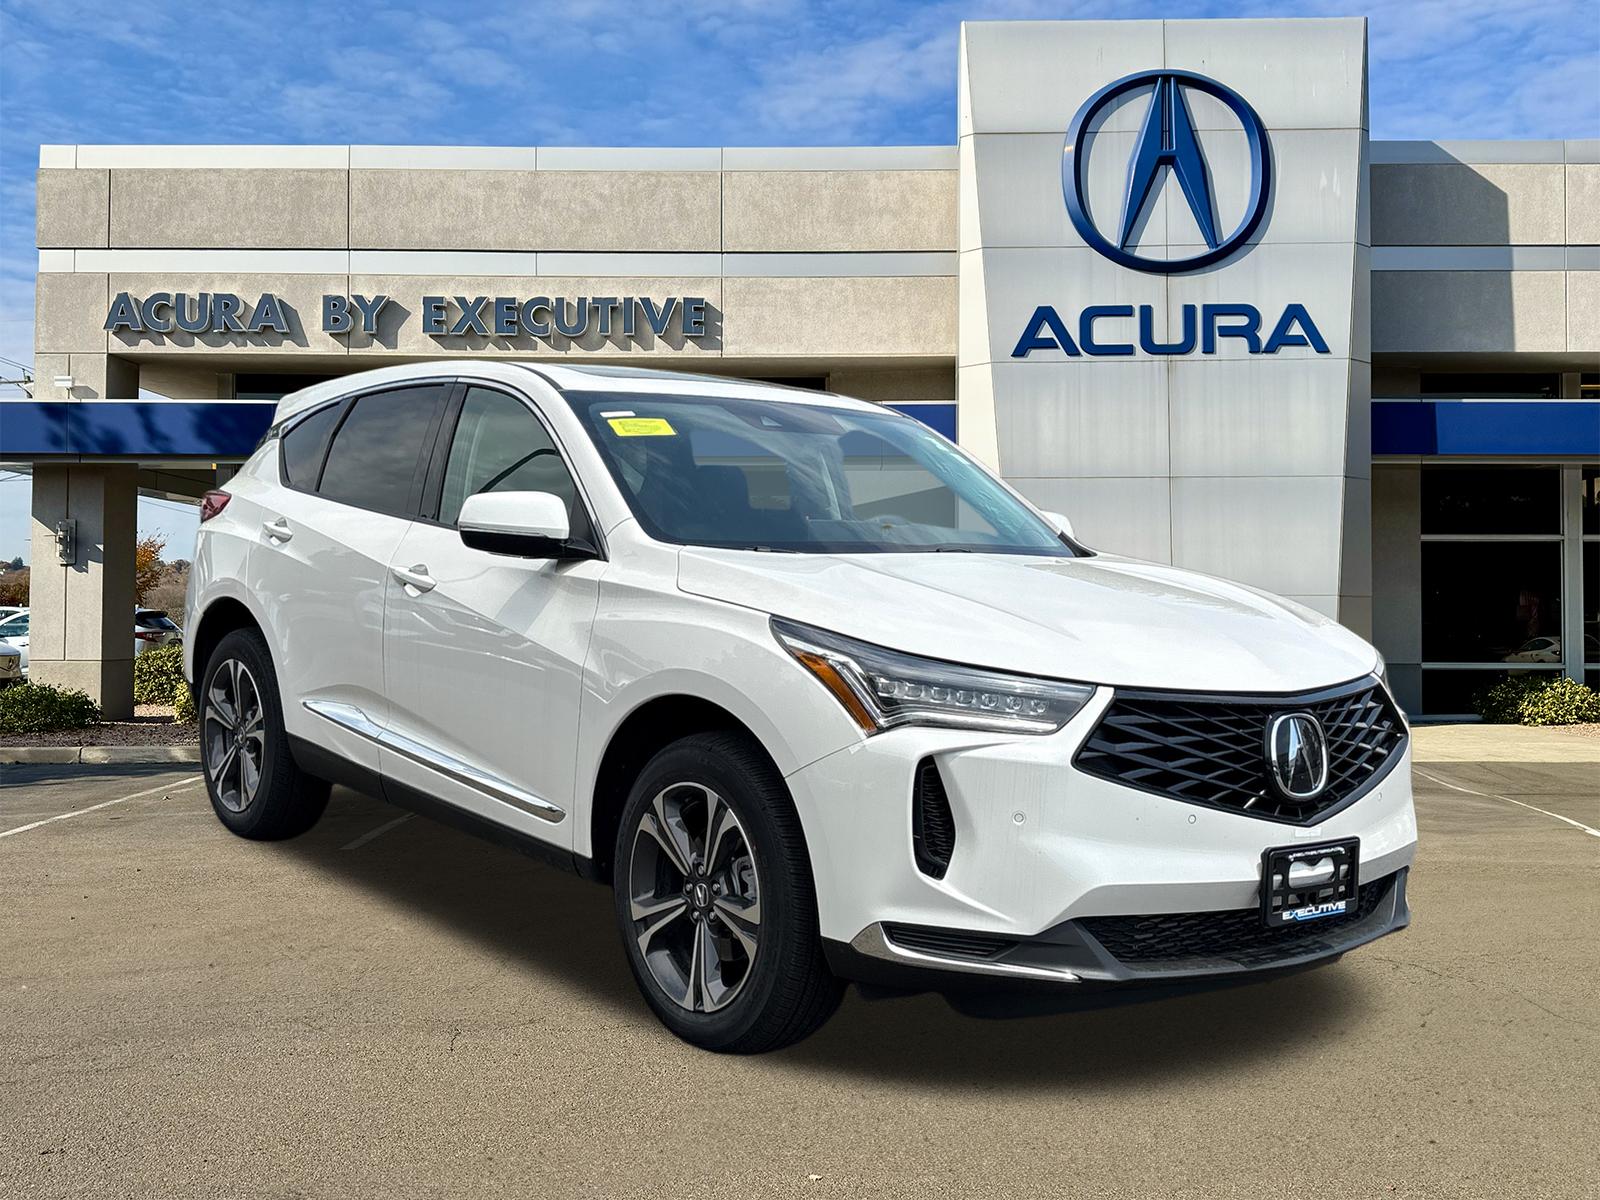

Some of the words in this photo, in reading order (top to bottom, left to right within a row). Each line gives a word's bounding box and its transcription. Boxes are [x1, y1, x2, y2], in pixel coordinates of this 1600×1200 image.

[103, 292, 290, 333] ACURA
[322, 295, 390, 334] BY
[422, 296, 706, 337] EXECUTIVE
[1011, 304, 1331, 357] ACURA
[1282, 901, 1346, 920] EXECUTIVE
